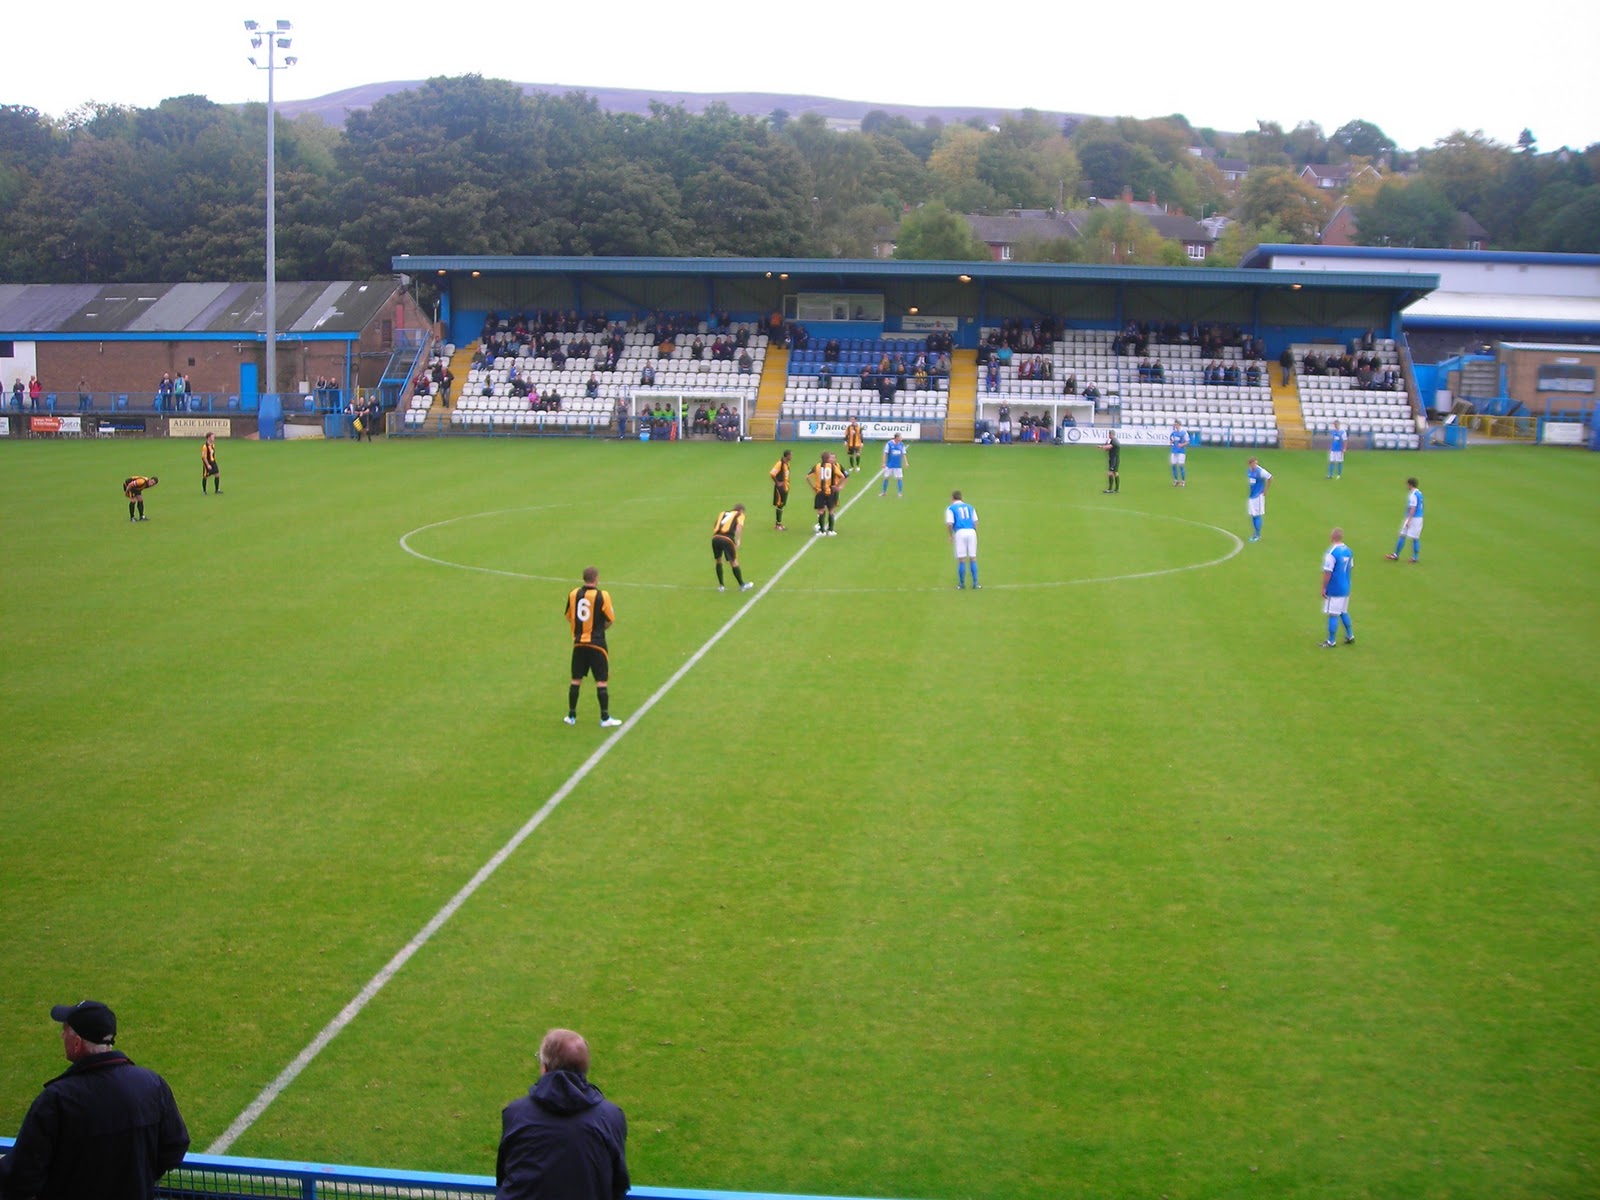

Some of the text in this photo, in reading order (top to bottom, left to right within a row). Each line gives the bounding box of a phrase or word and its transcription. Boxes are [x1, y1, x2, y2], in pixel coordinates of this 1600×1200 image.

[173, 419, 197, 427] ALKIE
[820, 422, 912, 432] Tamee Council
[1134, 430, 1142, 439] &
[1146, 430, 1169, 440] Sons
[820, 466, 832, 480] 10
[720, 511, 732, 525] 7
[958, 506, 970, 519] 11
[577, 598, 591, 622] 6
